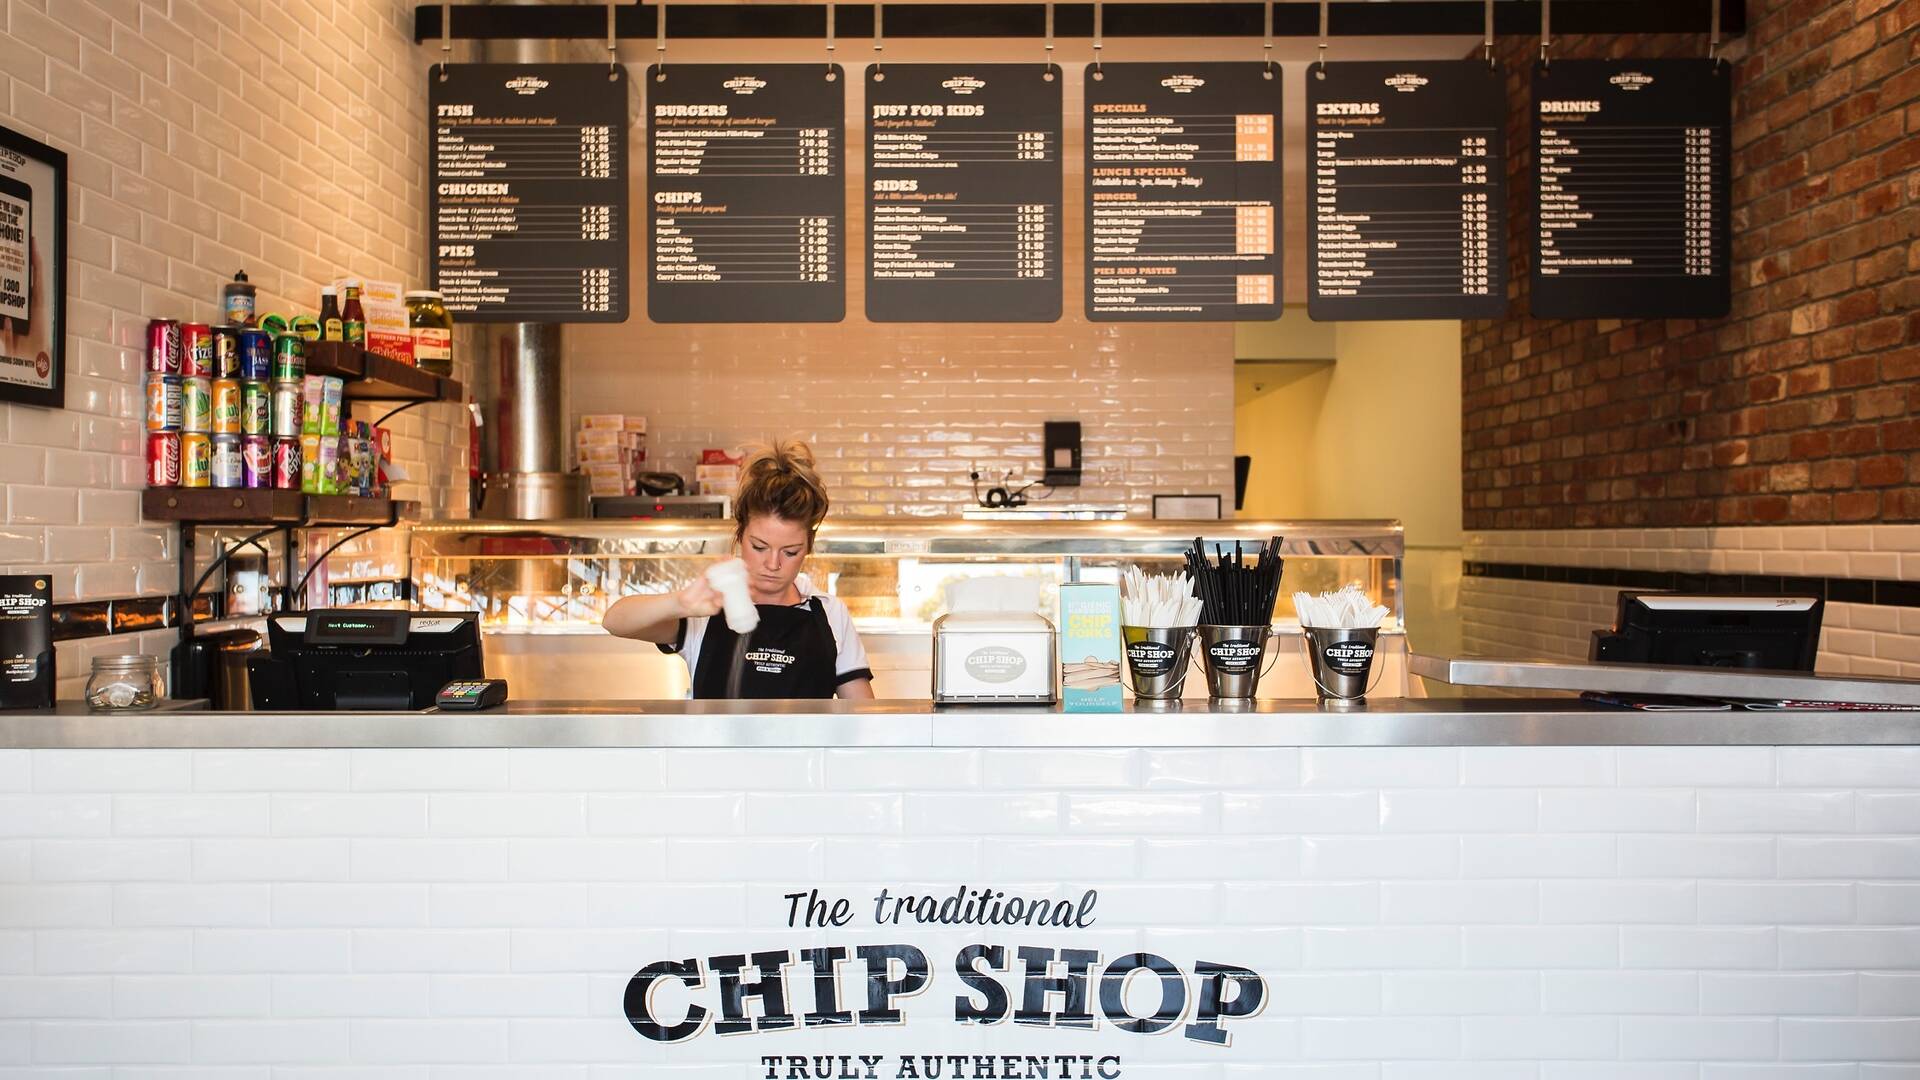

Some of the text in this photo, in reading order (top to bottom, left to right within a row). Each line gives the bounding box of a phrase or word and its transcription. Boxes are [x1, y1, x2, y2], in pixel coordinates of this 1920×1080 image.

[438, 105, 474, 116] FISH
[655, 105, 728, 116] BURGERS
[873, 105, 985, 119] JUST FOR KIDS
[1092, 104, 1147, 112] SPECIALS
[1316, 103, 1380, 115] EXTRAS
[1540, 101, 1600, 112] DRINKS
[1092, 168, 1187, 176] LUNCH SPECIALS
[438, 184, 510, 195] CHICKEN
[874, 180, 918, 192] SIDES
[654, 192, 702, 204] CHIPS
[1094, 192, 1137, 200] BURGERS
[438, 245, 474, 257] PIES
[1094, 267, 1176, 275] PIES AND PASTIES
[19, 598, 46, 607] SHOP
[1069, 614, 1112, 628] CHIP
[1147, 650, 1174, 658] SHOP
[1210, 648, 1260, 656] CHIP SHOP
[1326, 649, 1373, 658] CHIP SHOP
[745, 652, 795, 664] CHIP SHOP
[784, 885, 1098, 928] The traditional
[623, 944, 1269, 1047] CHIP SHOP
[761, 1055, 1121, 1080] TRULY AUTHENTIC
